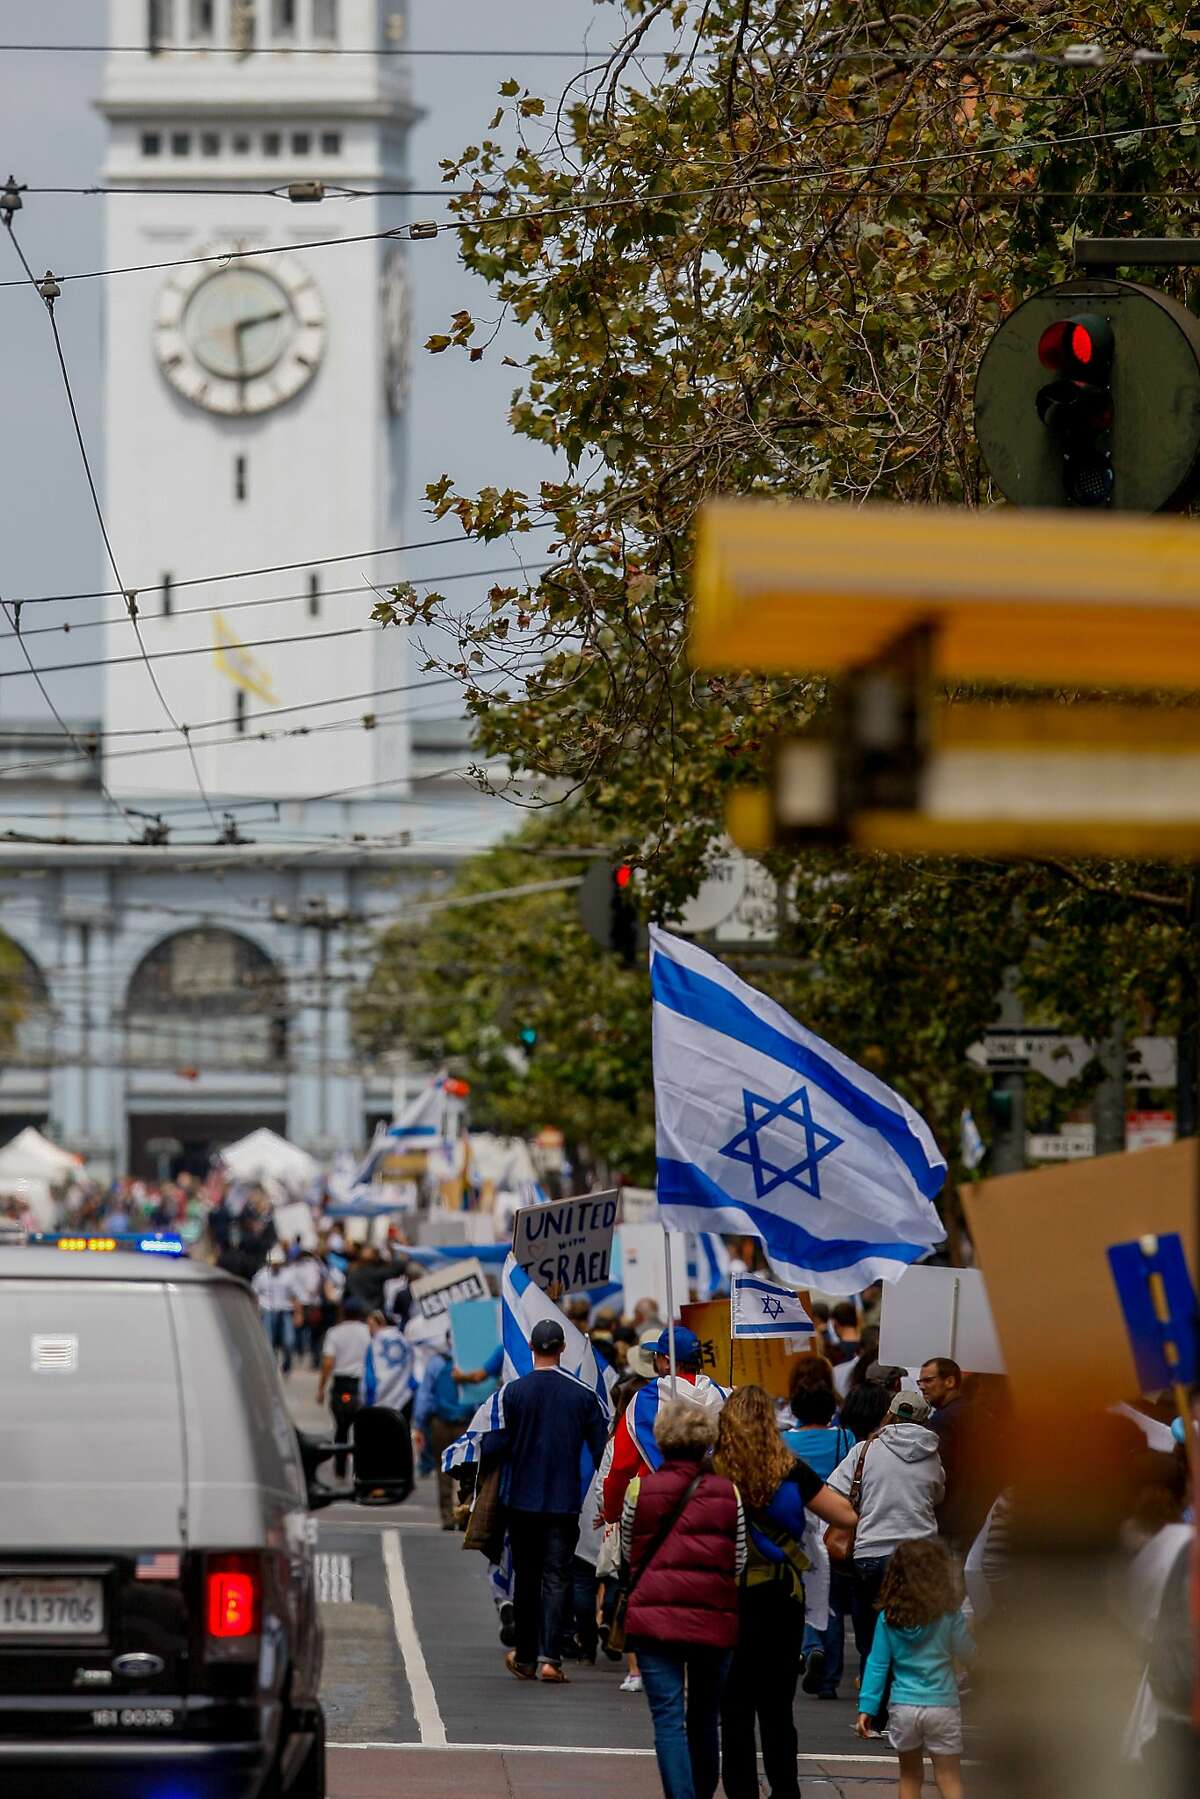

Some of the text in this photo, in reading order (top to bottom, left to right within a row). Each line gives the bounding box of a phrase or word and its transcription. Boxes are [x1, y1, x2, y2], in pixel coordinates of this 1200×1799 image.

[526, 1201, 616, 1241] UNITED
[558, 1237, 586, 1249] WITH
[3, 1596, 95, 1624] 1413706
